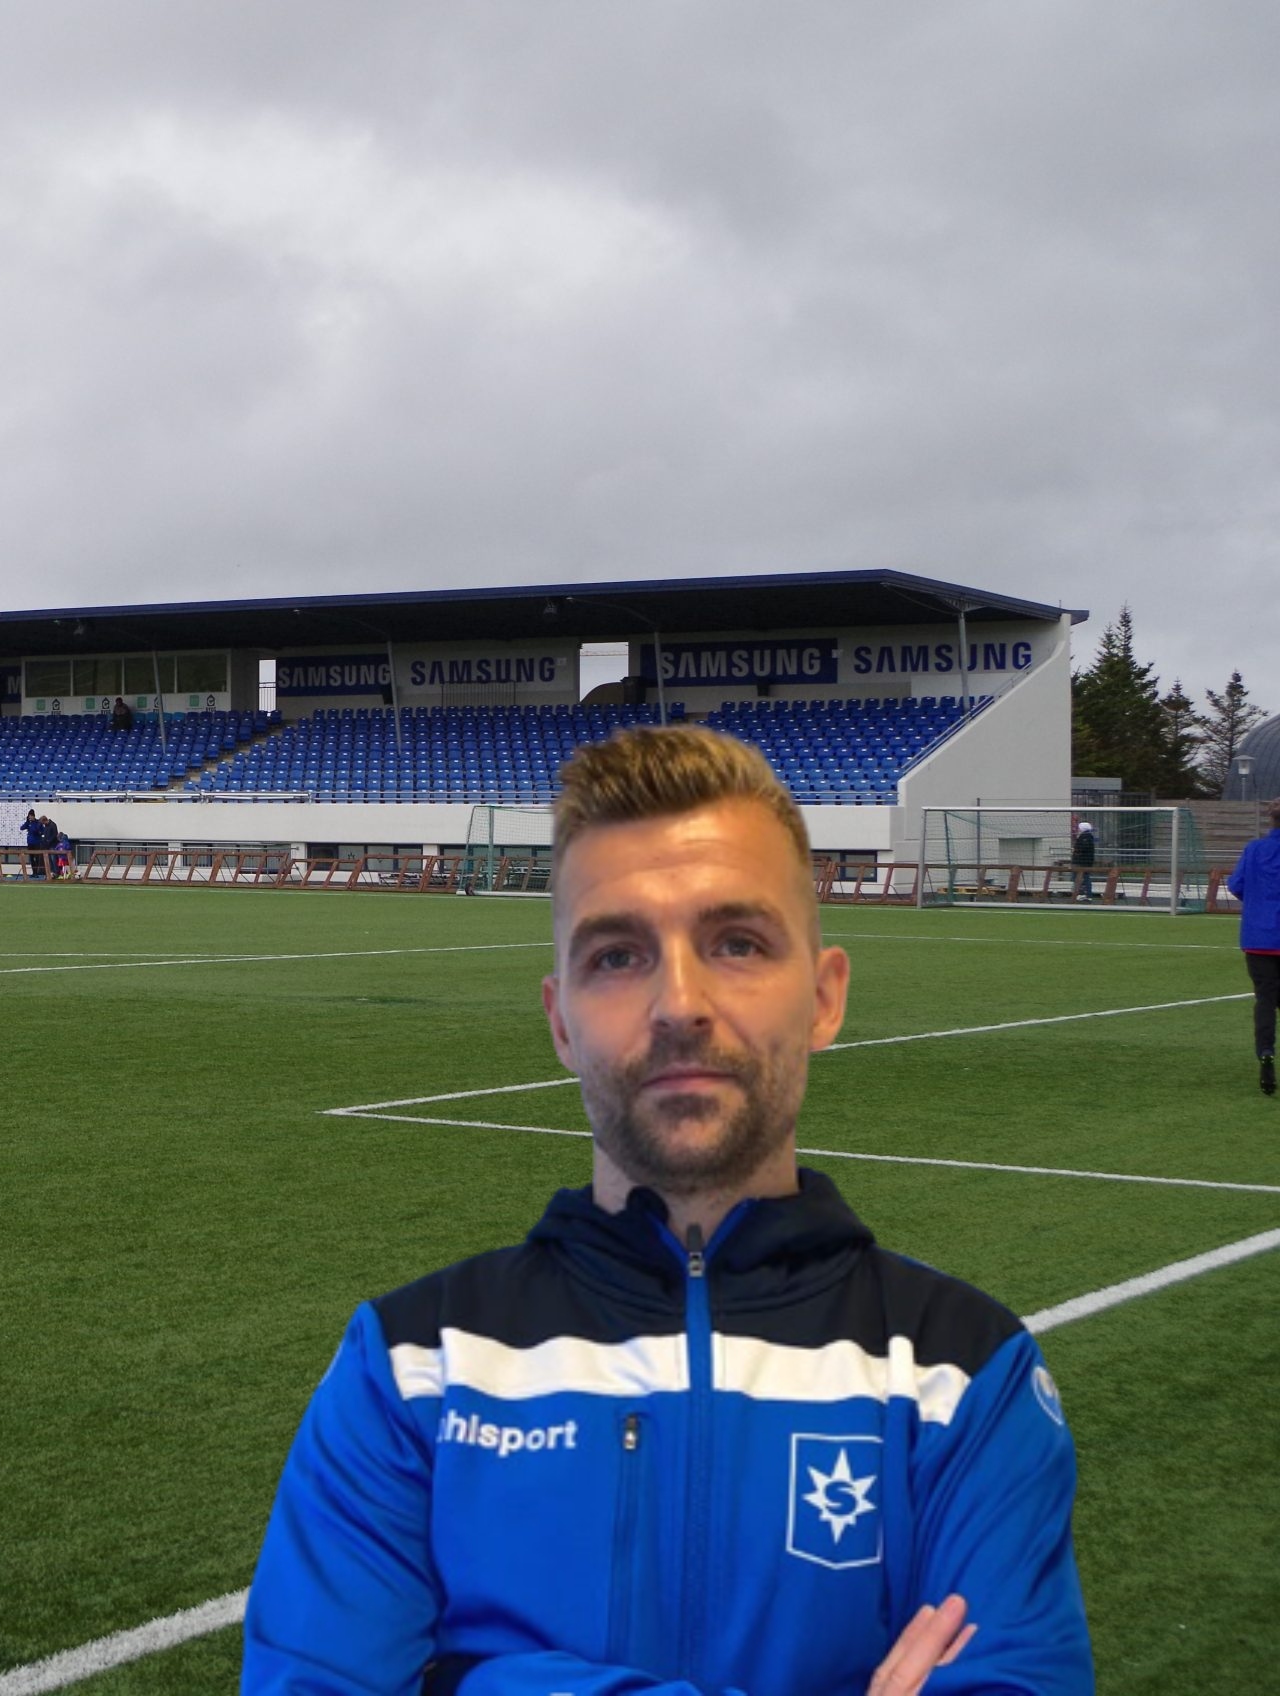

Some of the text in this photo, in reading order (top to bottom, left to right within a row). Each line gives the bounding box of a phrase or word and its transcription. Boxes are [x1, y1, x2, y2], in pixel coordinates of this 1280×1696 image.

[411, 656, 555, 686] SAMSUNG
[660, 647, 821, 679] SAMSUNG
[854, 641, 1032, 674] SAMSUNG
[278, 662, 391, 689] SAMSUNG
